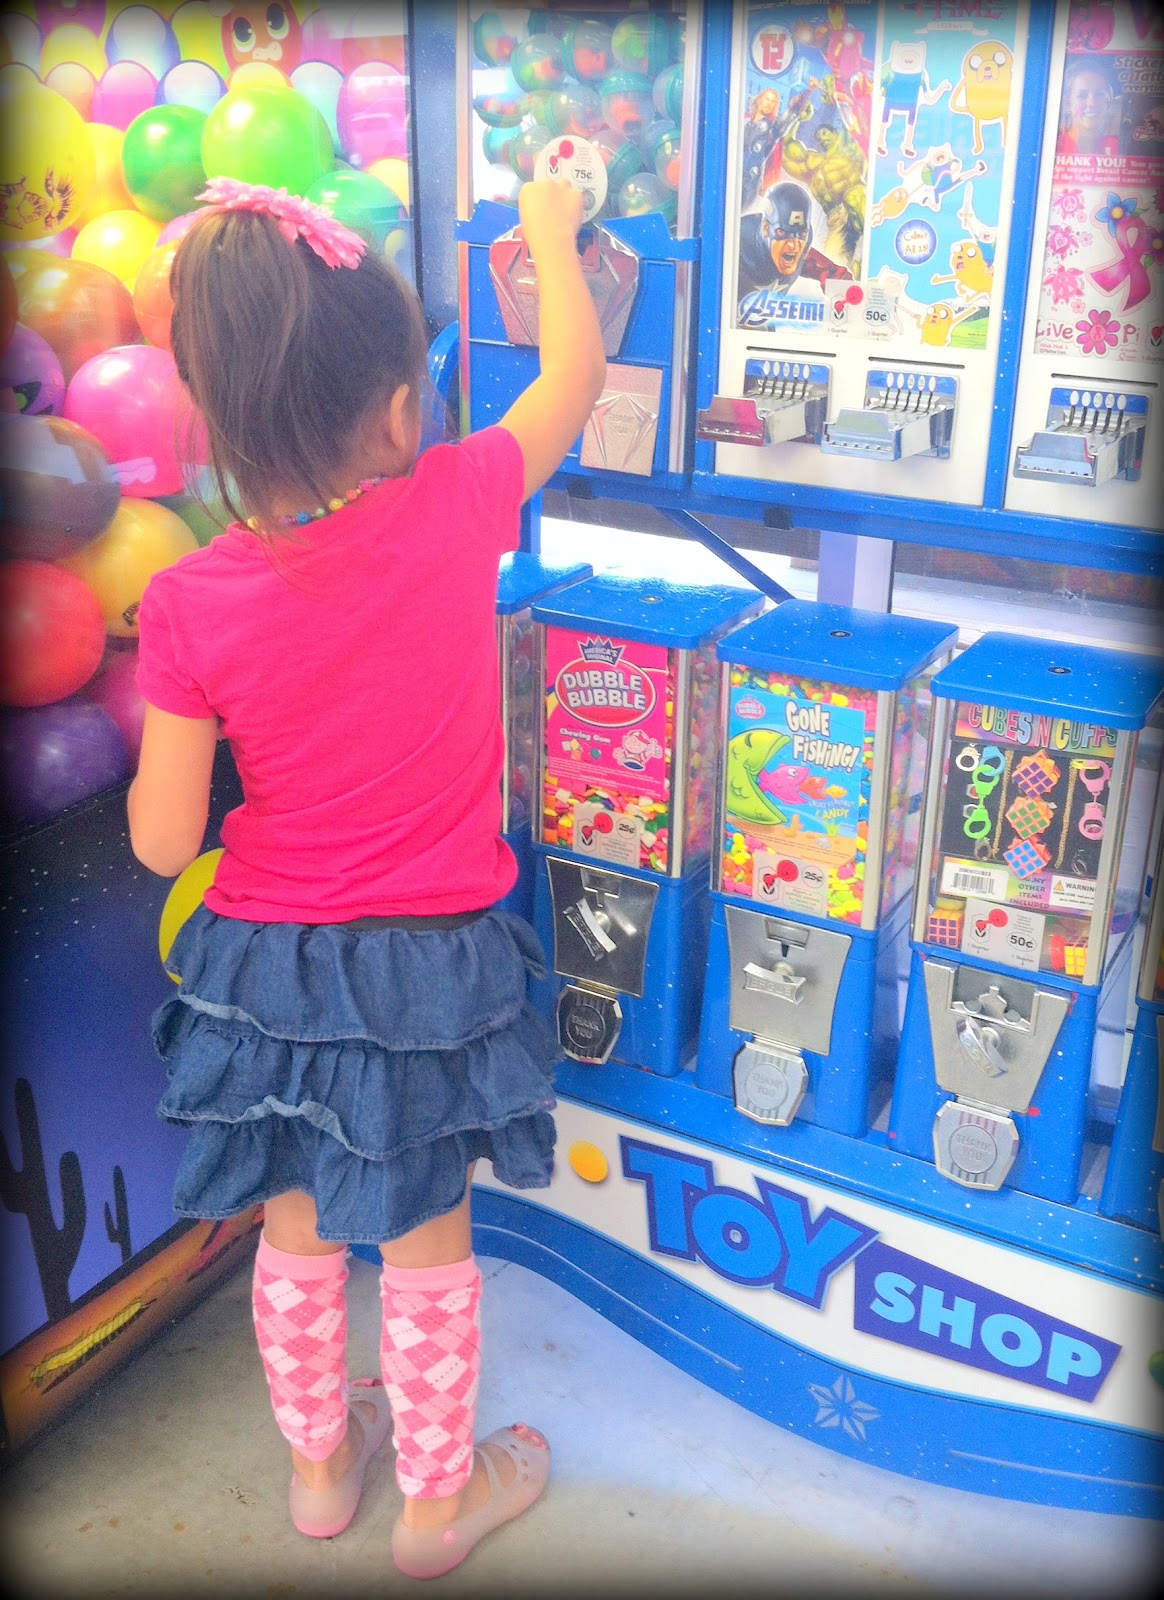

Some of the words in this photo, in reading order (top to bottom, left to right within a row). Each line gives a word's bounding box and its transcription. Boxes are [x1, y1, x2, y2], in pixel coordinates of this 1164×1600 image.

[1134, 70, 1164, 82] Tatt
[1055, 155, 1091, 166] HANK
[1095, 157, 1126, 168] YOU!
[1123, 323, 1140, 343] Pi
[562, 670, 642, 692] DUBBLE
[567, 688, 646, 711] BUBBLE
[785, 699, 831, 738] GONE
[967, 702, 1032, 745] CUBES
[1035, 716, 1051, 748] N
[1055, 717, 1118, 750] CUFFS
[560, 727, 591, 742] Chewing
[815, 808, 849, 820] CANDY
[804, 871, 823, 882] 25¢
[1018, 883, 1046, 892] OTHER
[1065, 882, 1095, 892] WARNIN
[1019, 891, 1043, 900] ITEMS
[1010, 897, 1050, 909] INCLUDED
[956, 1133, 992, 1152] THANK
[621, 1137, 876, 1310] TOY
[869, 1271, 1103, 1385] SHOP
